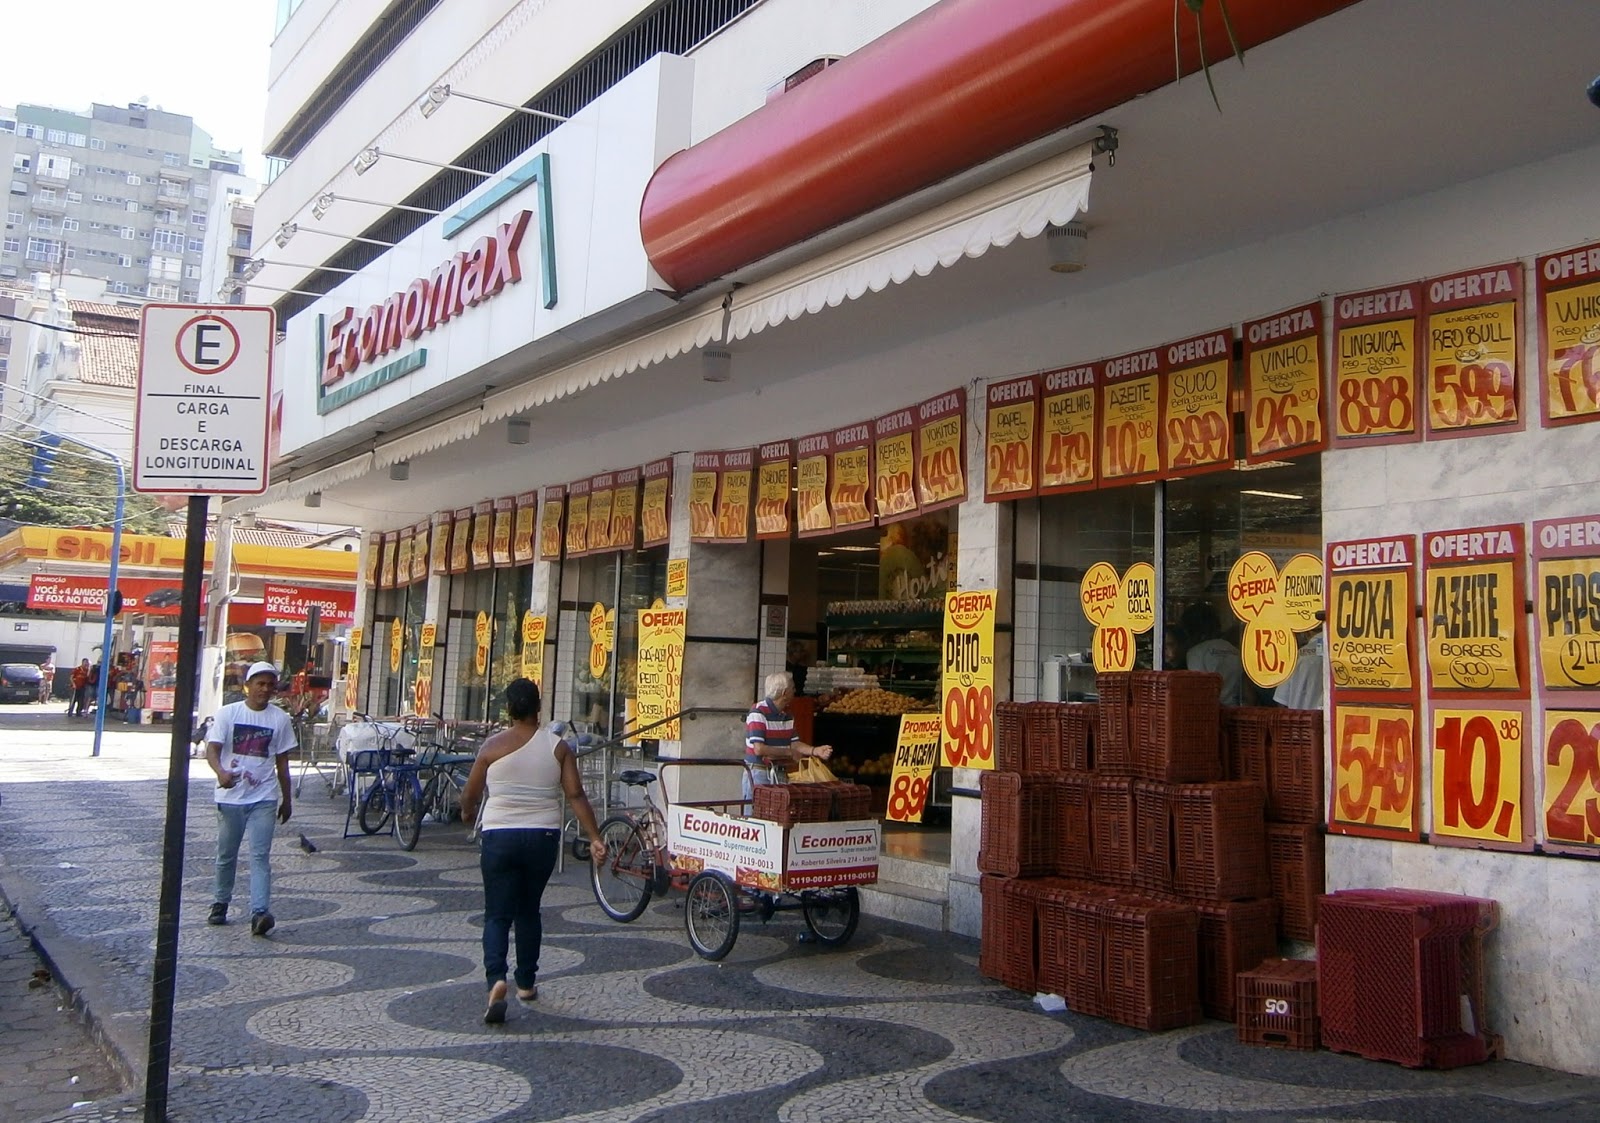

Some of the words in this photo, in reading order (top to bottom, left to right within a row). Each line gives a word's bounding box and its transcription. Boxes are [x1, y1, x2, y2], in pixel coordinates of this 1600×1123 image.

[1429, 269, 1513, 304] OFERTA
[321, 209, 533, 387] Economax
[1340, 289, 1414, 320] OFERTA
[1249, 309, 1314, 344] OFERTA
[1432, 328, 1464, 352] RED
[1466, 322, 1512, 345] BULL
[195, 324, 221, 365] E
[1168, 334, 1227, 365] OFERTA
[1342, 330, 1406, 359] LINGUIÇA
[1105, 351, 1158, 378] OFERTA
[1260, 344, 1308, 374] VINHO
[184, 384, 225, 395] FINAL
[1046, 367, 1095, 391] OFERTA
[1173, 370, 1217, 398] SUCO
[990, 380, 1034, 403] OFERTA
[1109, 383, 1152, 409] AZEITE
[1432, 362, 1514, 427] 5,99
[176, 402, 230, 415] CARGA
[920, 393, 959, 420] OFERTA
[1049, 398, 1076, 418] PAPEL
[1340, 375, 1412, 434] 8,98
[198, 421, 206, 432] E
[877, 411, 912, 434] OFERTA
[996, 411, 1027, 428] PAPEL
[1138, 420, 1153, 439] 98
[160, 438, 243, 452] DESCARGA
[798, 436, 829, 454] OFERTA
[835, 425, 869, 446] OFERTA
[725, 452, 751, 466] OFERTA
[761, 442, 790, 459] OFERTA
[145, 456, 255, 471] LONGITUDINAL
[645, 461, 668, 477] OFERTA
[592, 474, 613, 488] OFERTA
[617, 469, 638, 483] OFERTA
[1332, 541, 1408, 566] OFERTA
[1429, 530, 1515, 558] OFERTA
[35, 585, 57, 595] VOCÊ
[1082, 584, 1118, 604] OFERTA
[1127, 579, 1150, 598] COCA
[1231, 577, 1277, 602] OFERTA
[1284, 575, 1323, 597] PRESUNTO
[33, 594, 44, 602] DE
[46, 594, 65, 603] FOX
[66, 595, 81, 603] NO
[266, 604, 277, 612] DE
[279, 604, 296, 613] FOX
[268, 595, 290, 605] VOCÊ
[304, 600, 337, 609] AMIGOS
[948, 594, 993, 613] OFERTA
[1128, 599, 1152, 614] COLA
[1431, 573, 1499, 640] AZEITE
[642, 611, 684, 627] OFERTA
[1336, 579, 1395, 640] COXA
[946, 632, 980, 674] PEITO
[1349, 653, 1393, 669] COXA
[1440, 643, 1503, 658] BORGES
[1568, 639, 1585, 671] 2
[1453, 660, 1489, 676] 500
[944, 685, 993, 767] 9,98
[1499, 719, 1521, 741] 98
[1339, 714, 1412, 825] 5,49
[683, 813, 761, 842] Economax
[723, 840, 766, 855] Supermercado
[801, 834, 873, 848] Economax
[699, 848, 730, 861] 3119-0012
[739, 856, 774, 870] 3119-0013
[826, 857, 847, 865] Silveira
[790, 875, 832, 884] 3119-0012
[838, 871, 876, 881] 3119-0013
